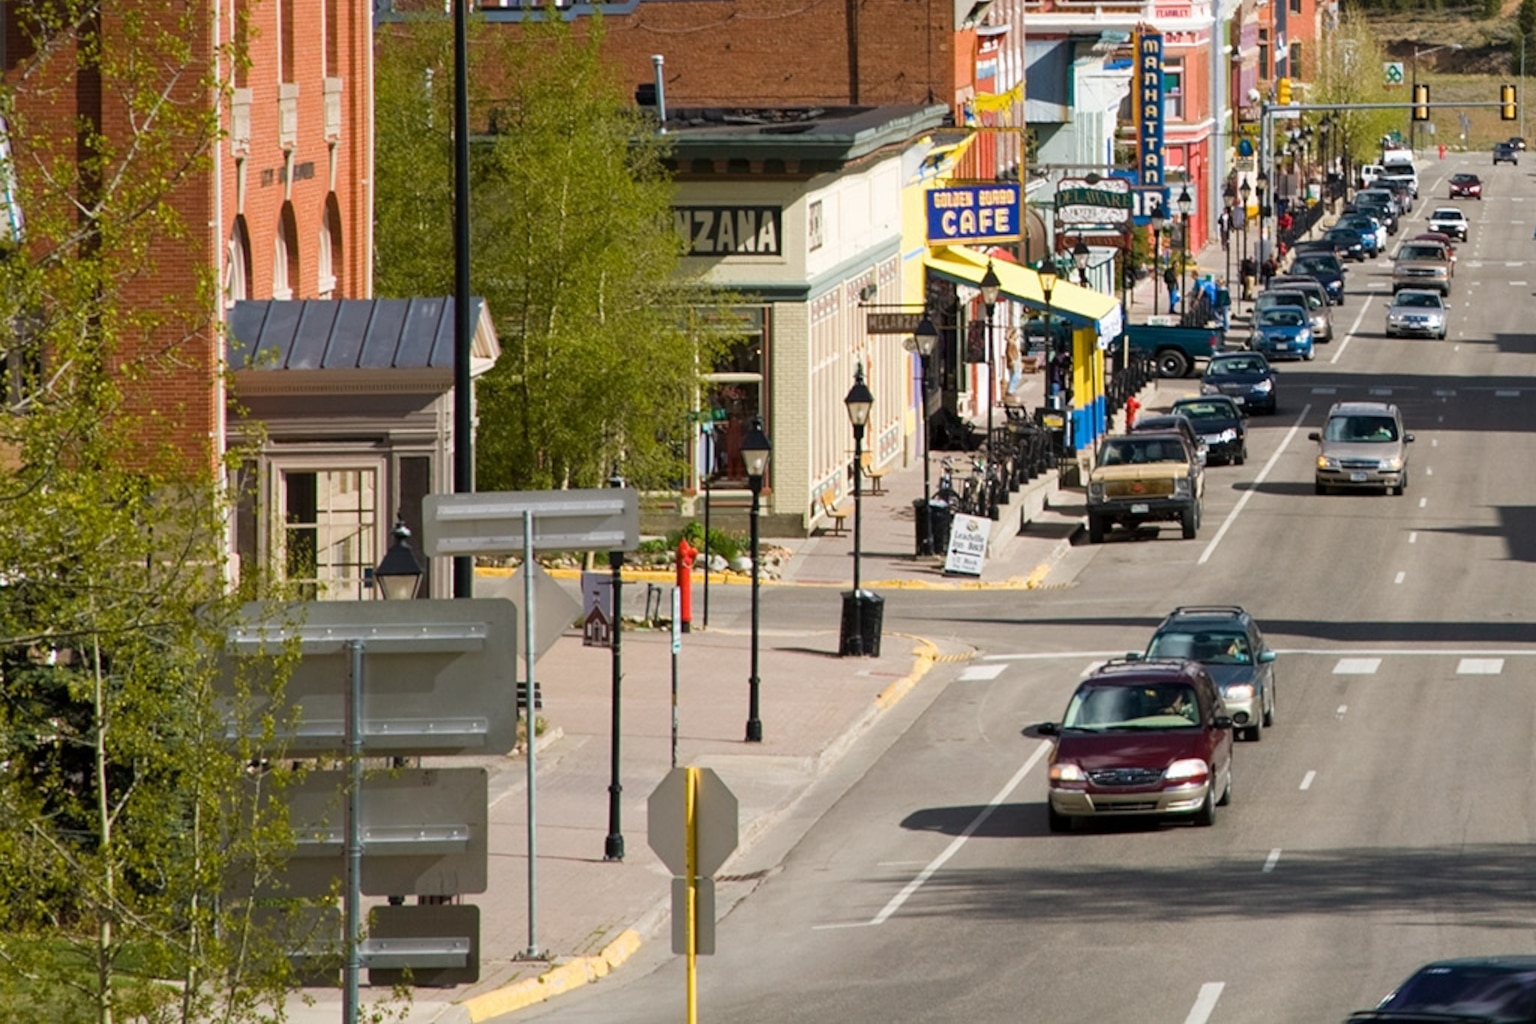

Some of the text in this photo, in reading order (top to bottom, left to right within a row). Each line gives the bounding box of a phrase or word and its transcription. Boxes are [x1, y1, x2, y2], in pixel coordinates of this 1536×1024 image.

[1143, 39, 1159, 184] MANHATTAN
[933, 188, 1015, 209] GOLDEN BURRO
[1056, 189, 1129, 207] DELAWARE
[674, 210, 777, 252] NZANA
[941, 207, 1010, 236] CAFE
